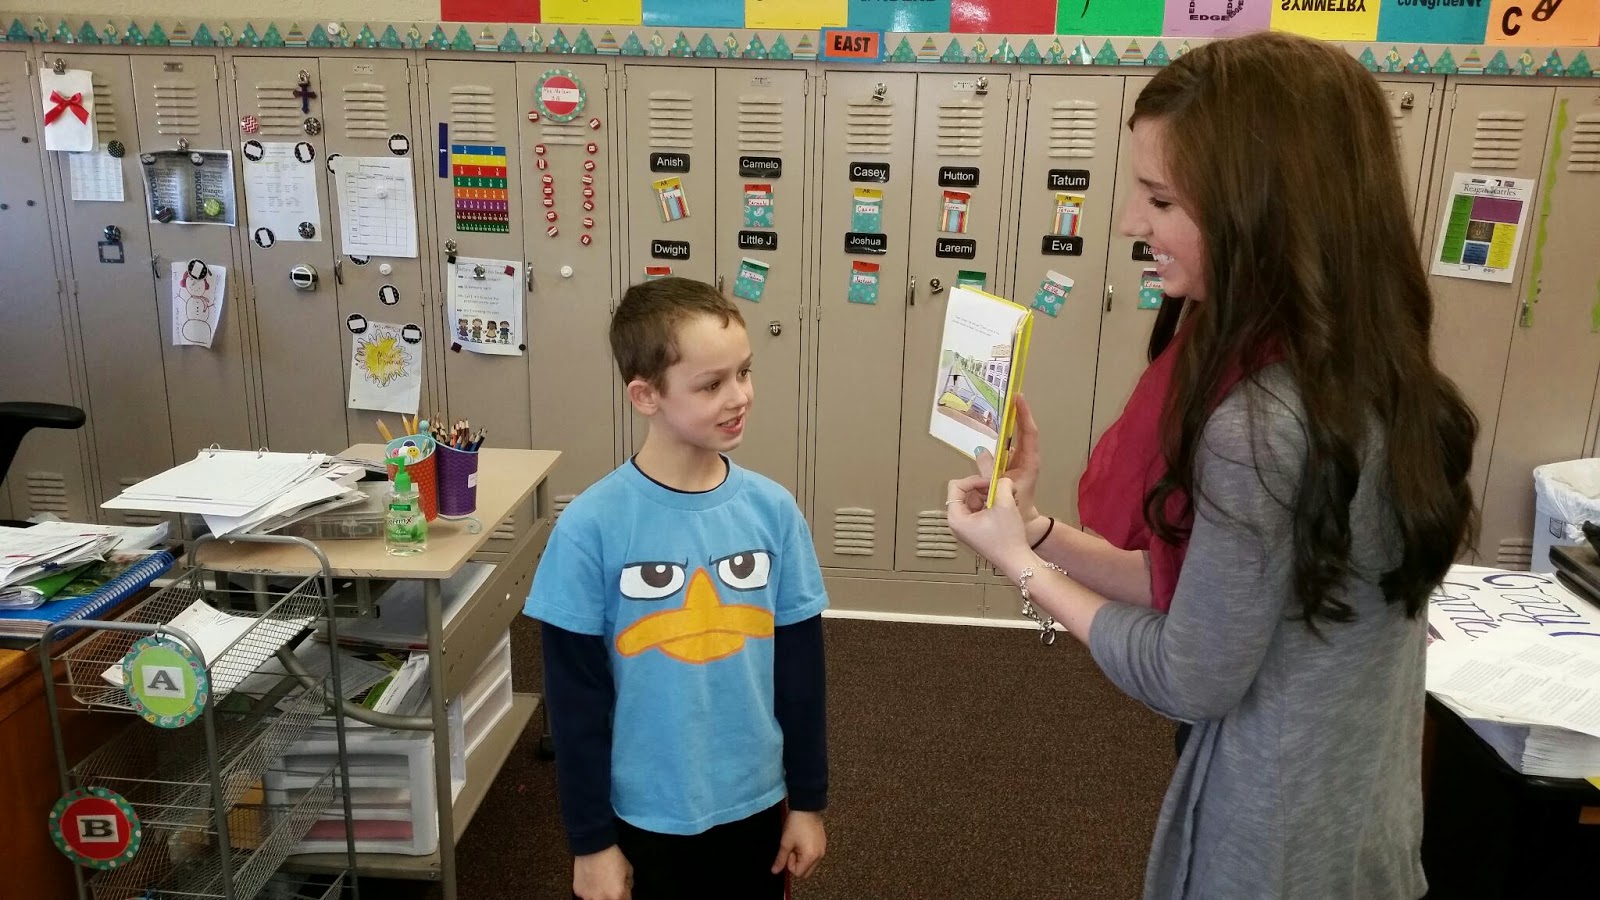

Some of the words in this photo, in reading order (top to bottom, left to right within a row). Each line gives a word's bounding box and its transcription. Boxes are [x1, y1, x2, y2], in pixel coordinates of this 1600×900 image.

[834, 35, 870, 53] EAST
[656, 156, 684, 168] Anish
[742, 159, 779, 170] Carmelo
[853, 167, 886, 178] Casey
[943, 171, 974, 181] Hutton
[1051, 174, 1086, 186] Tatum
[740, 235, 764, 245] Little
[765, 236, 775, 246] J.
[850, 236, 881, 246] Joshua
[1052, 240, 1073, 251] Eva
[654, 243, 688, 256] Dwight
[939, 243, 973, 253] Laremi
[147, 669, 179, 691] A
[80, 819, 113, 837] B
